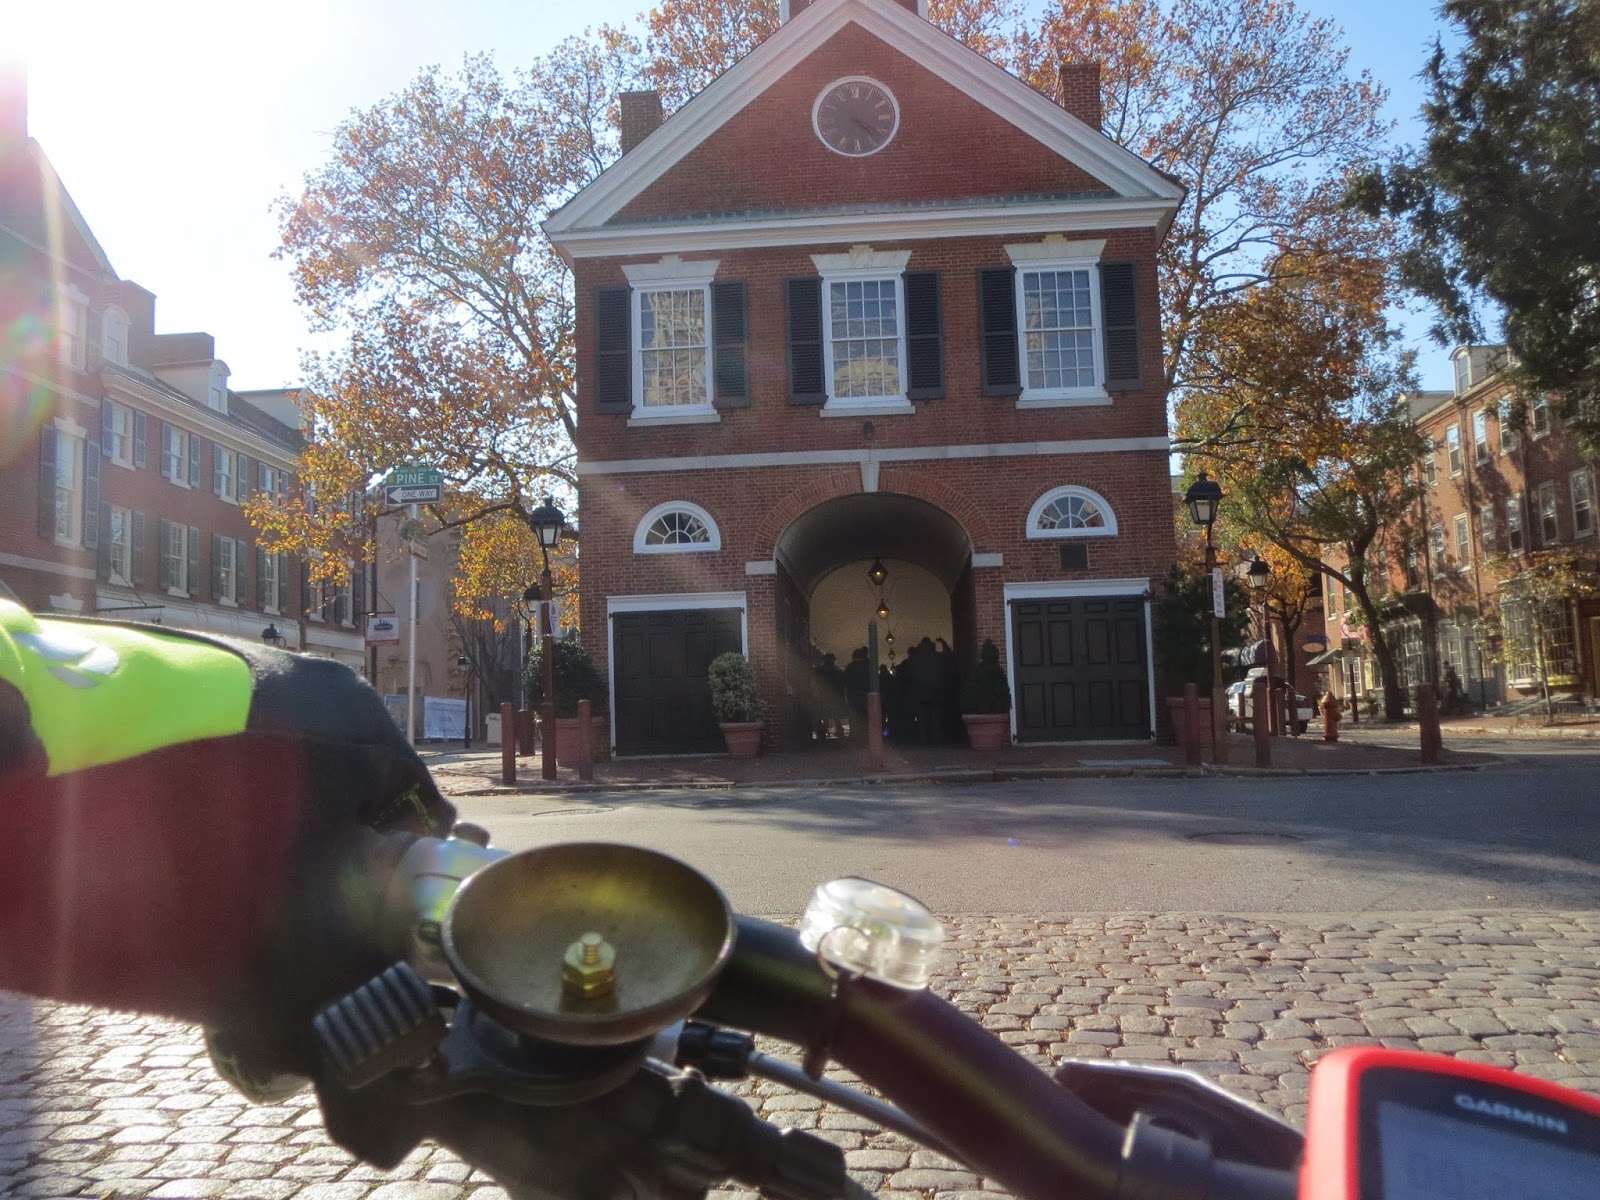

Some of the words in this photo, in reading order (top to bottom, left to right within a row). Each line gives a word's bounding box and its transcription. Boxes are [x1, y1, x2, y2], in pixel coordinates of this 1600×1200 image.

[396, 473, 425, 484] PINE
[429, 475, 438, 483] ST
[402, 490, 417, 498] ONE
[1455, 1093, 1568, 1133] GARMIN
